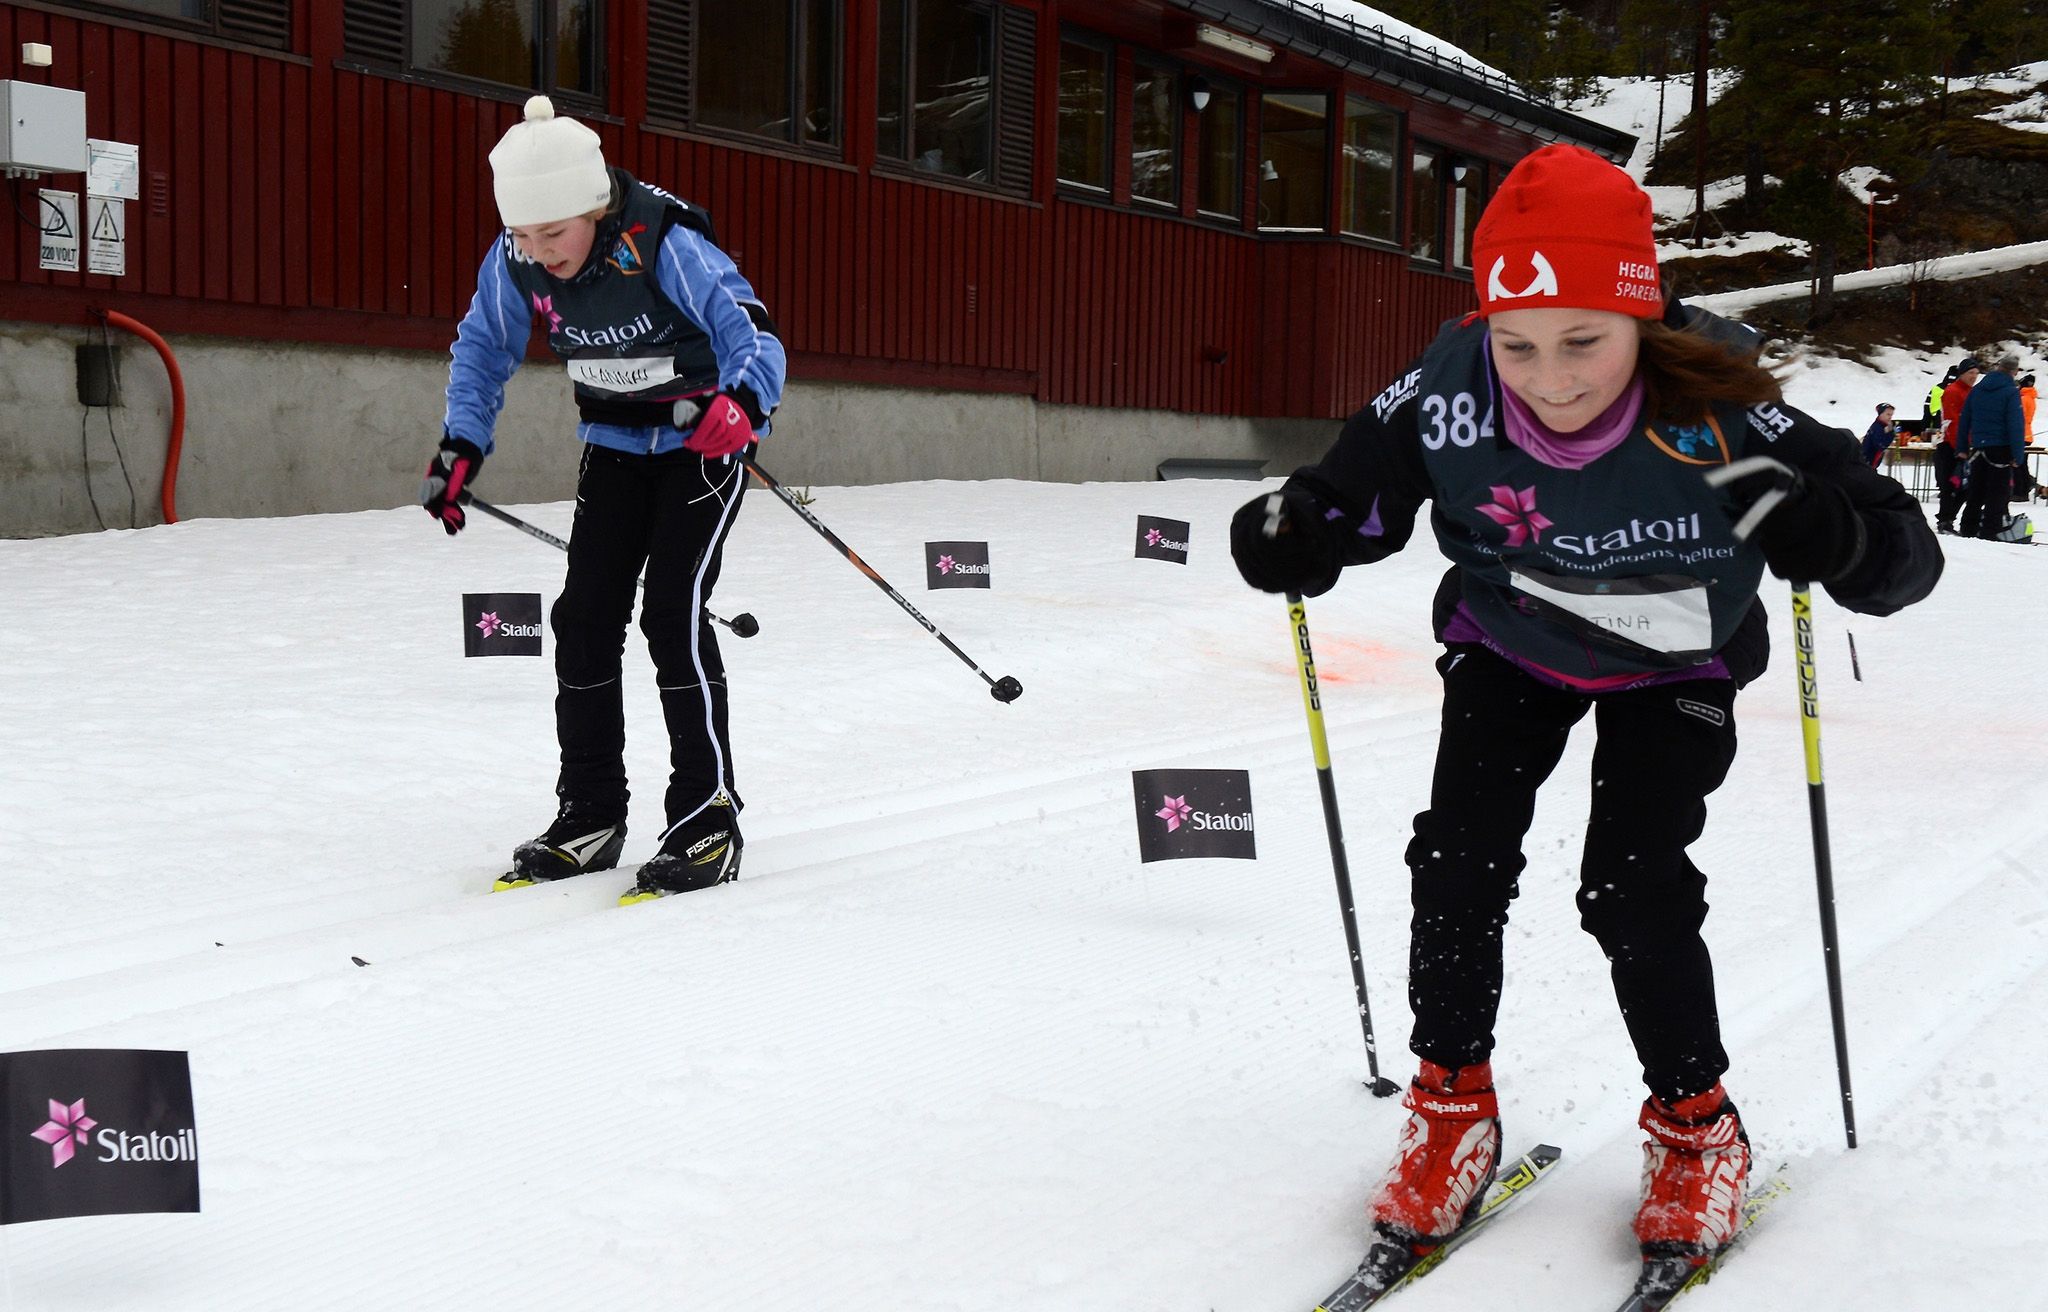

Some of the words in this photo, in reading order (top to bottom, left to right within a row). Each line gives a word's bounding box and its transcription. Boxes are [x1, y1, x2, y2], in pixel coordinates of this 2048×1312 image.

[42, 245, 55, 261] 220
[56, 246, 77, 262] VOLT
[1618, 261, 1655, 281] HEGRA
[564, 313, 654, 347] Statoil
[1553, 513, 1700, 556] Statoil
[955, 563, 989, 575] Statoil
[500, 622, 541, 637] Statoil
[1797, 617, 1820, 718] FISCHER
[1191, 811, 1253, 832] Statoil
[685, 830, 730, 859] FISCHER
[1422, 1100, 1479, 1114] alpina
[97, 1128, 196, 1163] Statoil
